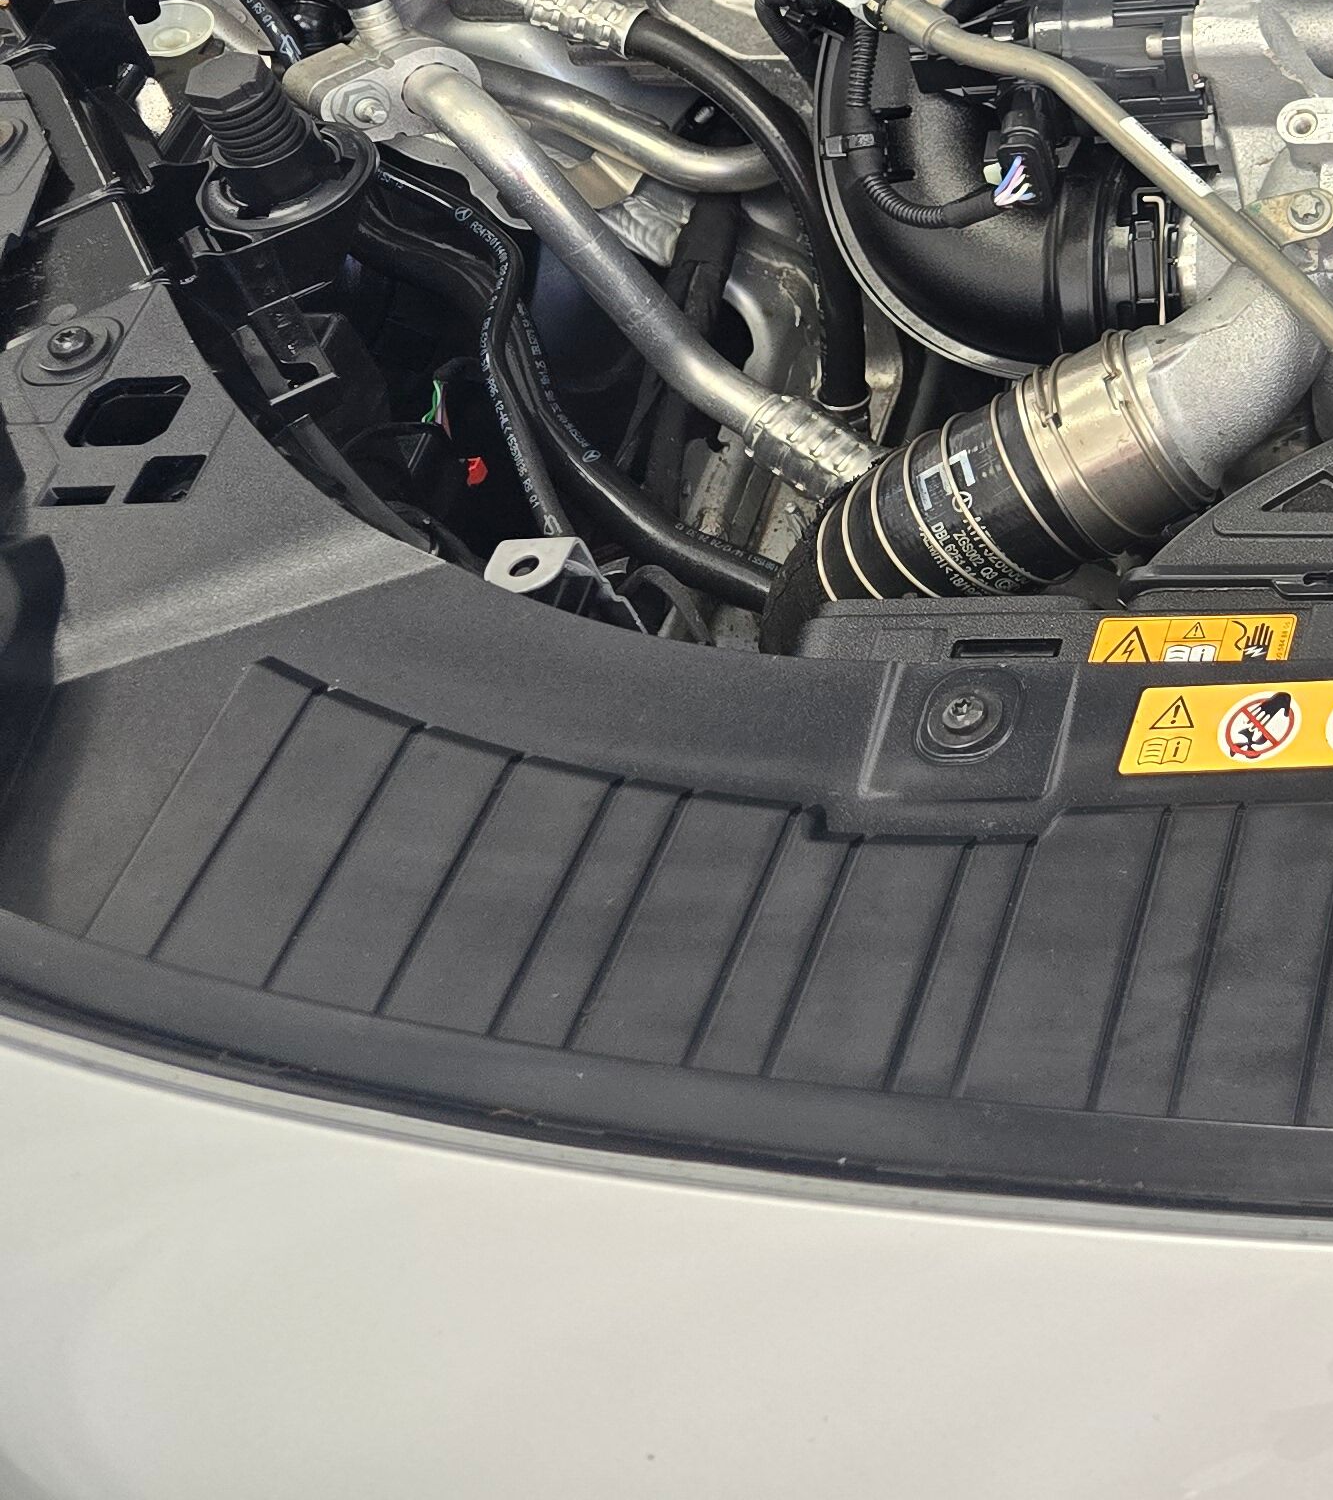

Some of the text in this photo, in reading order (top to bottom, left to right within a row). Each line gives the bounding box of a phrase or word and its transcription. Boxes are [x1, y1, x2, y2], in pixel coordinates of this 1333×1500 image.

[931, 521, 950, 546] DBL
[953, 529, 998, 580] ZGS002 Q3
